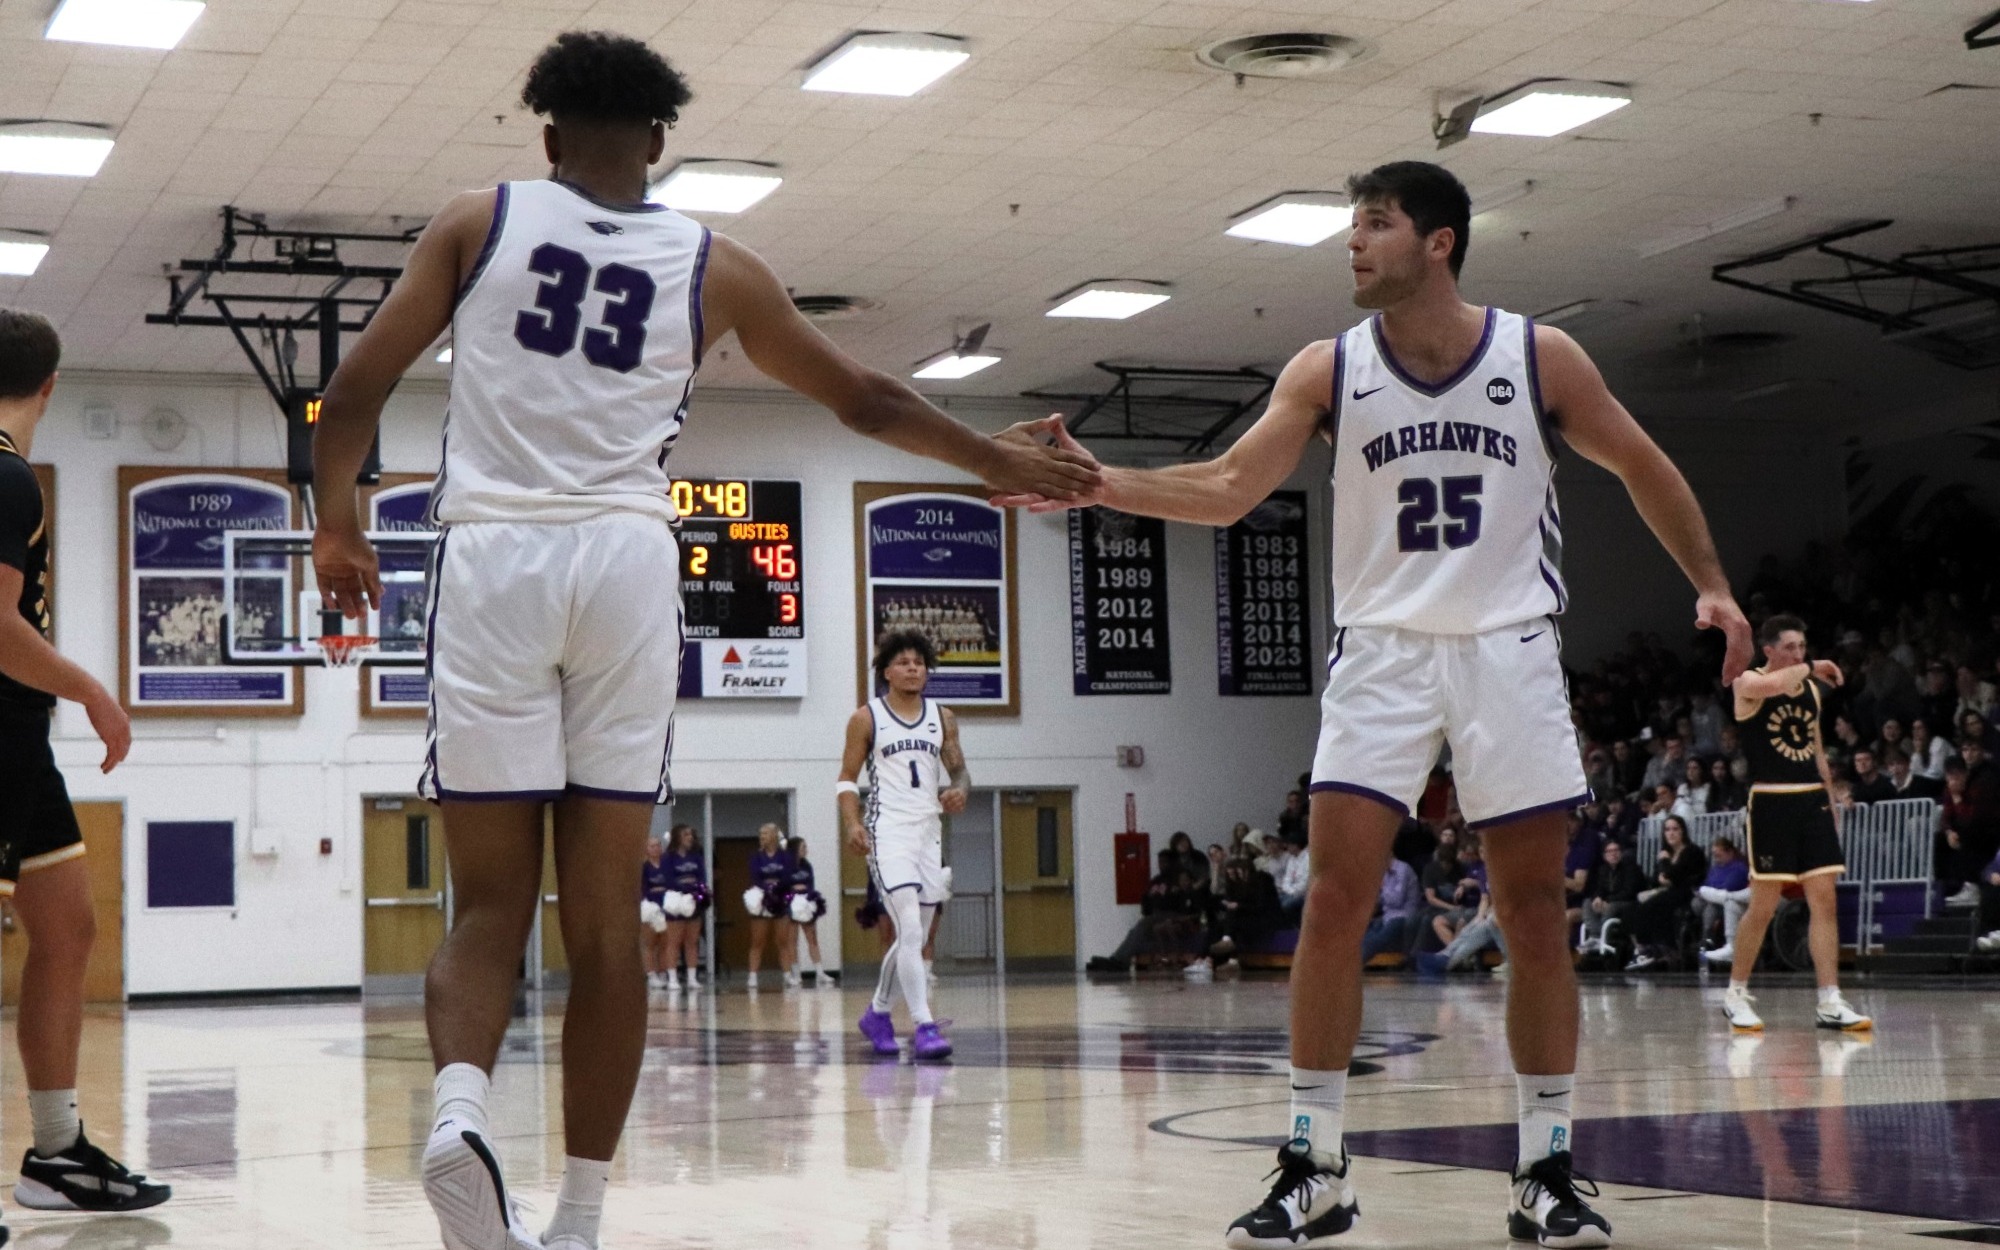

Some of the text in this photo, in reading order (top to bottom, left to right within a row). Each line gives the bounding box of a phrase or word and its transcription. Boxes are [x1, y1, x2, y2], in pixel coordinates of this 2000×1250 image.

[513, 241, 657, 375] 33
[1488, 385, 1513, 398] DG4
[1361, 420, 1518, 473] WARHAWKS
[189, 494, 232, 512] 1989
[137, 511, 283, 534] NATIONAL CHAMPIONS
[915, 508, 955, 525] 2014
[1396, 474, 1483, 553] 25
[680, 531, 718, 543] PERIOD
[729, 523, 789, 541] GUSTIES
[872, 525, 998, 549] NATIONAL CHAMPIONS
[1097, 538, 1152, 558] 1984
[1242, 536, 1299, 555] 1983
[690, 546, 709, 575] 2
[753, 545, 797, 579] 46
[1242, 558, 1300, 577] 1984
[683, 581, 735, 592] YER FOUL
[768, 581, 800, 592] FOULS
[1097, 568, 1153, 588] 1989
[1070, 508, 1088, 675] MEN'S BASKETBALL
[1243, 580, 1300, 599] 1989
[781, 595, 797, 622] 3
[1097, 598, 1154, 618] 2012
[1216, 526, 1233, 676] MEN'S BASKETBA
[1242, 602, 1301, 622] 2012
[685, 626, 720, 637] MATCH
[768, 626, 801, 637] SCORE
[1099, 628, 1155, 649] 2014
[1243, 625, 1301, 644] 2014
[1244, 647, 1302, 666] 2023
[722, 674, 786, 688] FRAWLEY
[1105, 671, 1155, 680] NATIONAL
[881, 738, 940, 758] WARHAWKS
[909, 760, 920, 788] 1
